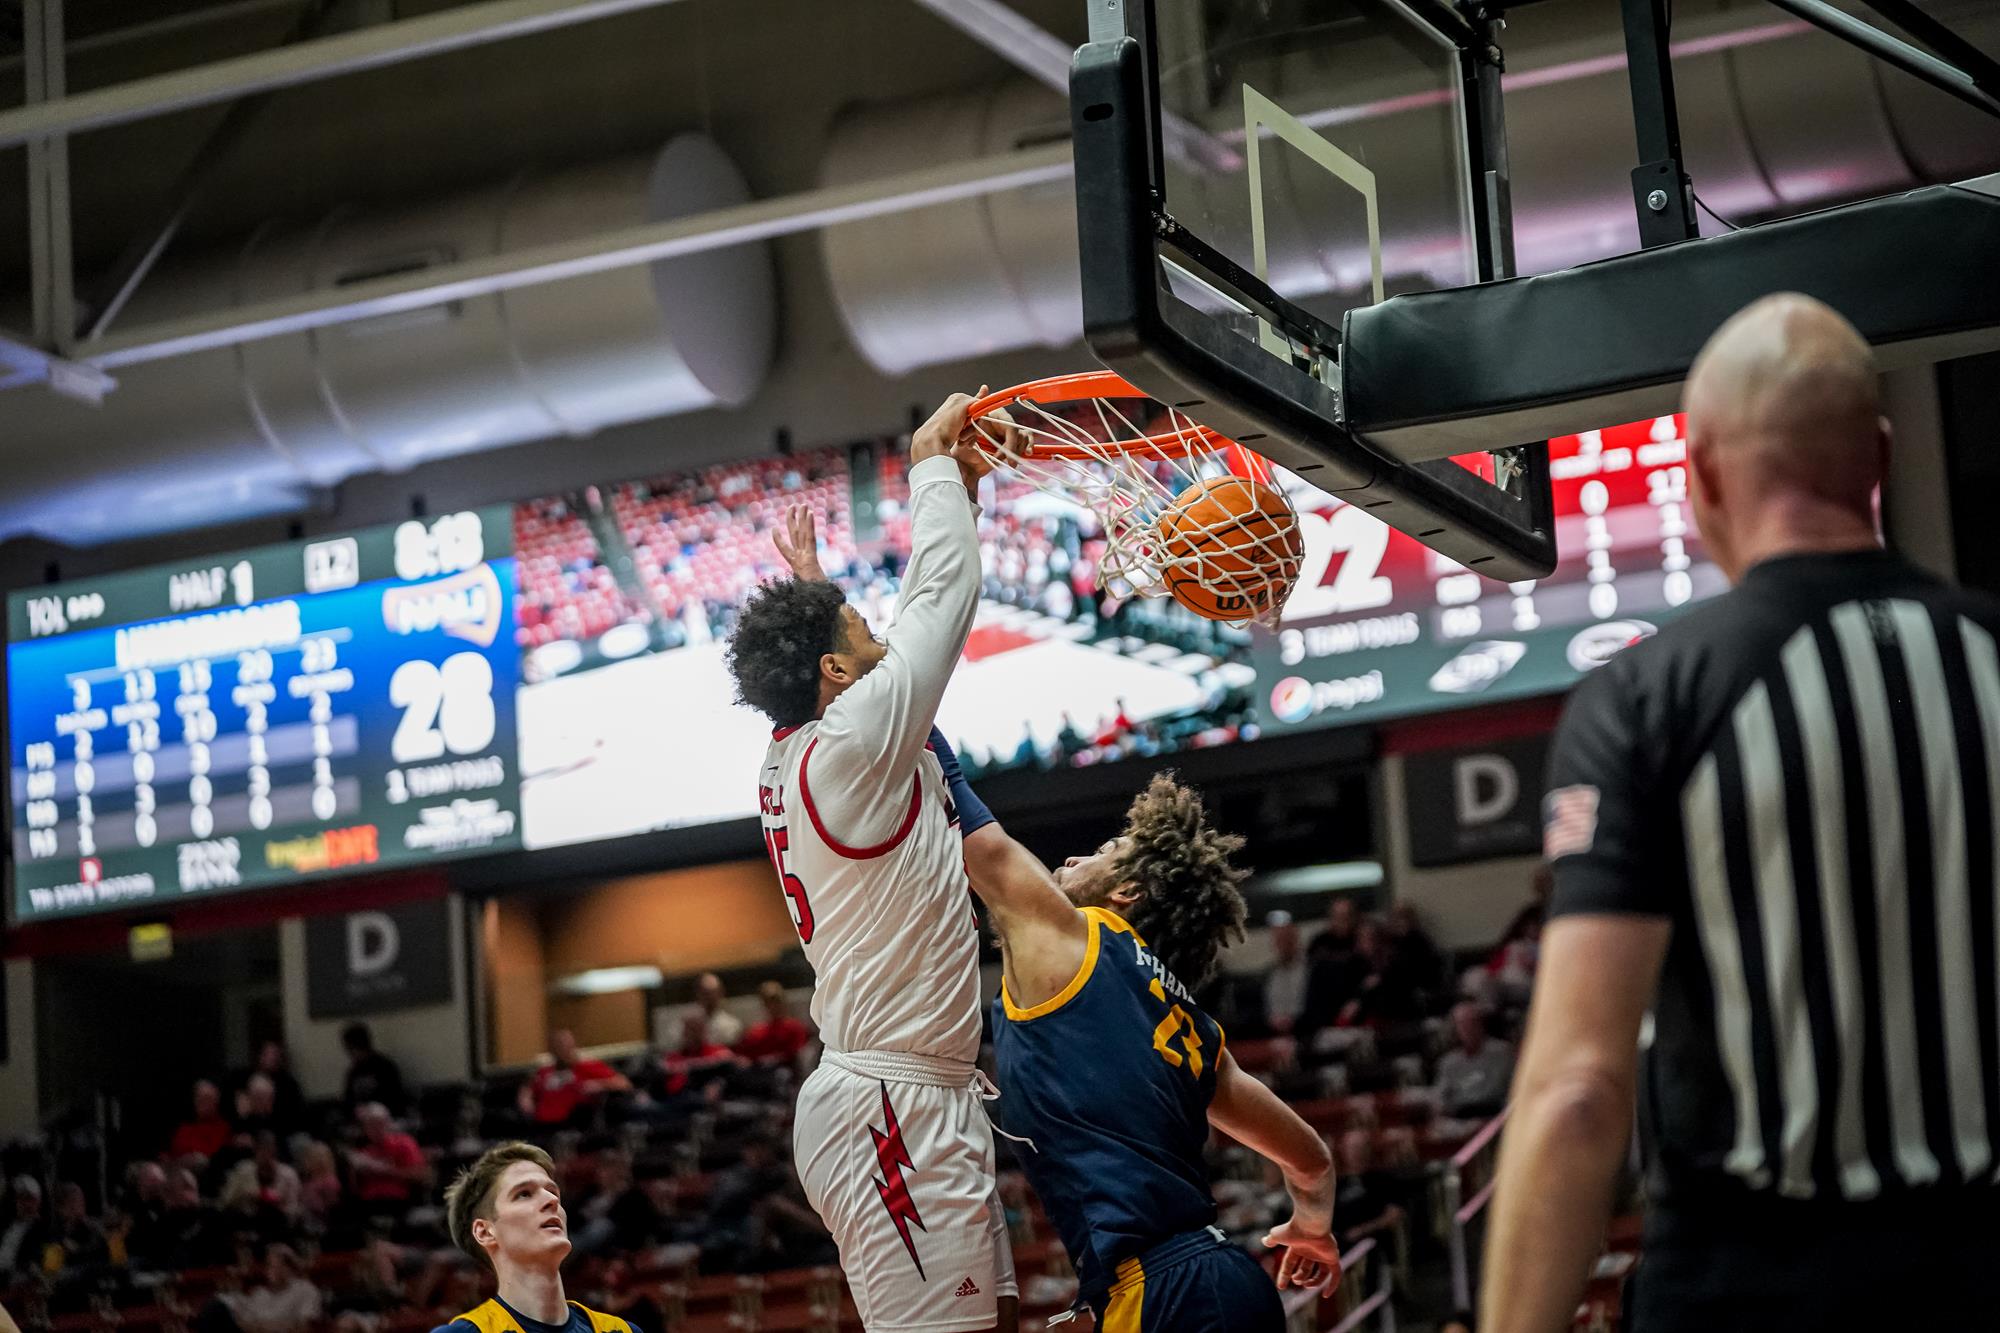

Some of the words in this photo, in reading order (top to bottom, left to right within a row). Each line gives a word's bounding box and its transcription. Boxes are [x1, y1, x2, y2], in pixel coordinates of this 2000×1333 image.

[1579, 480, 1609, 516] 0
[1584, 515, 1613, 550] 1
[1659, 502, 1687, 537] 1
[1586, 549, 1616, 584] 1
[1660, 535, 1690, 571] 1
[169, 566, 226, 612] HALF
[230, 560, 254, 606] 1
[1589, 582, 1618, 619] 0
[1663, 571, 1692, 607] 0
[27, 596, 68, 637] TOL
[1280, 629, 1305, 665] 3
[389, 652, 496, 763] 28
[1312, 669, 1384, 713] pepsi
[74, 760, 95, 794] 0
[133, 751, 155, 784] 0
[189, 774, 212, 807] 0
[385, 769, 409, 804] 1
[1455, 753, 1519, 825] D
[135, 813, 157, 848] 0
[190, 804, 213, 838] 0
[249, 795, 273, 830] 0
[312, 785, 336, 820] 0
[347, 911, 400, 974] D
[954, 1286, 980, 1298] adidas
